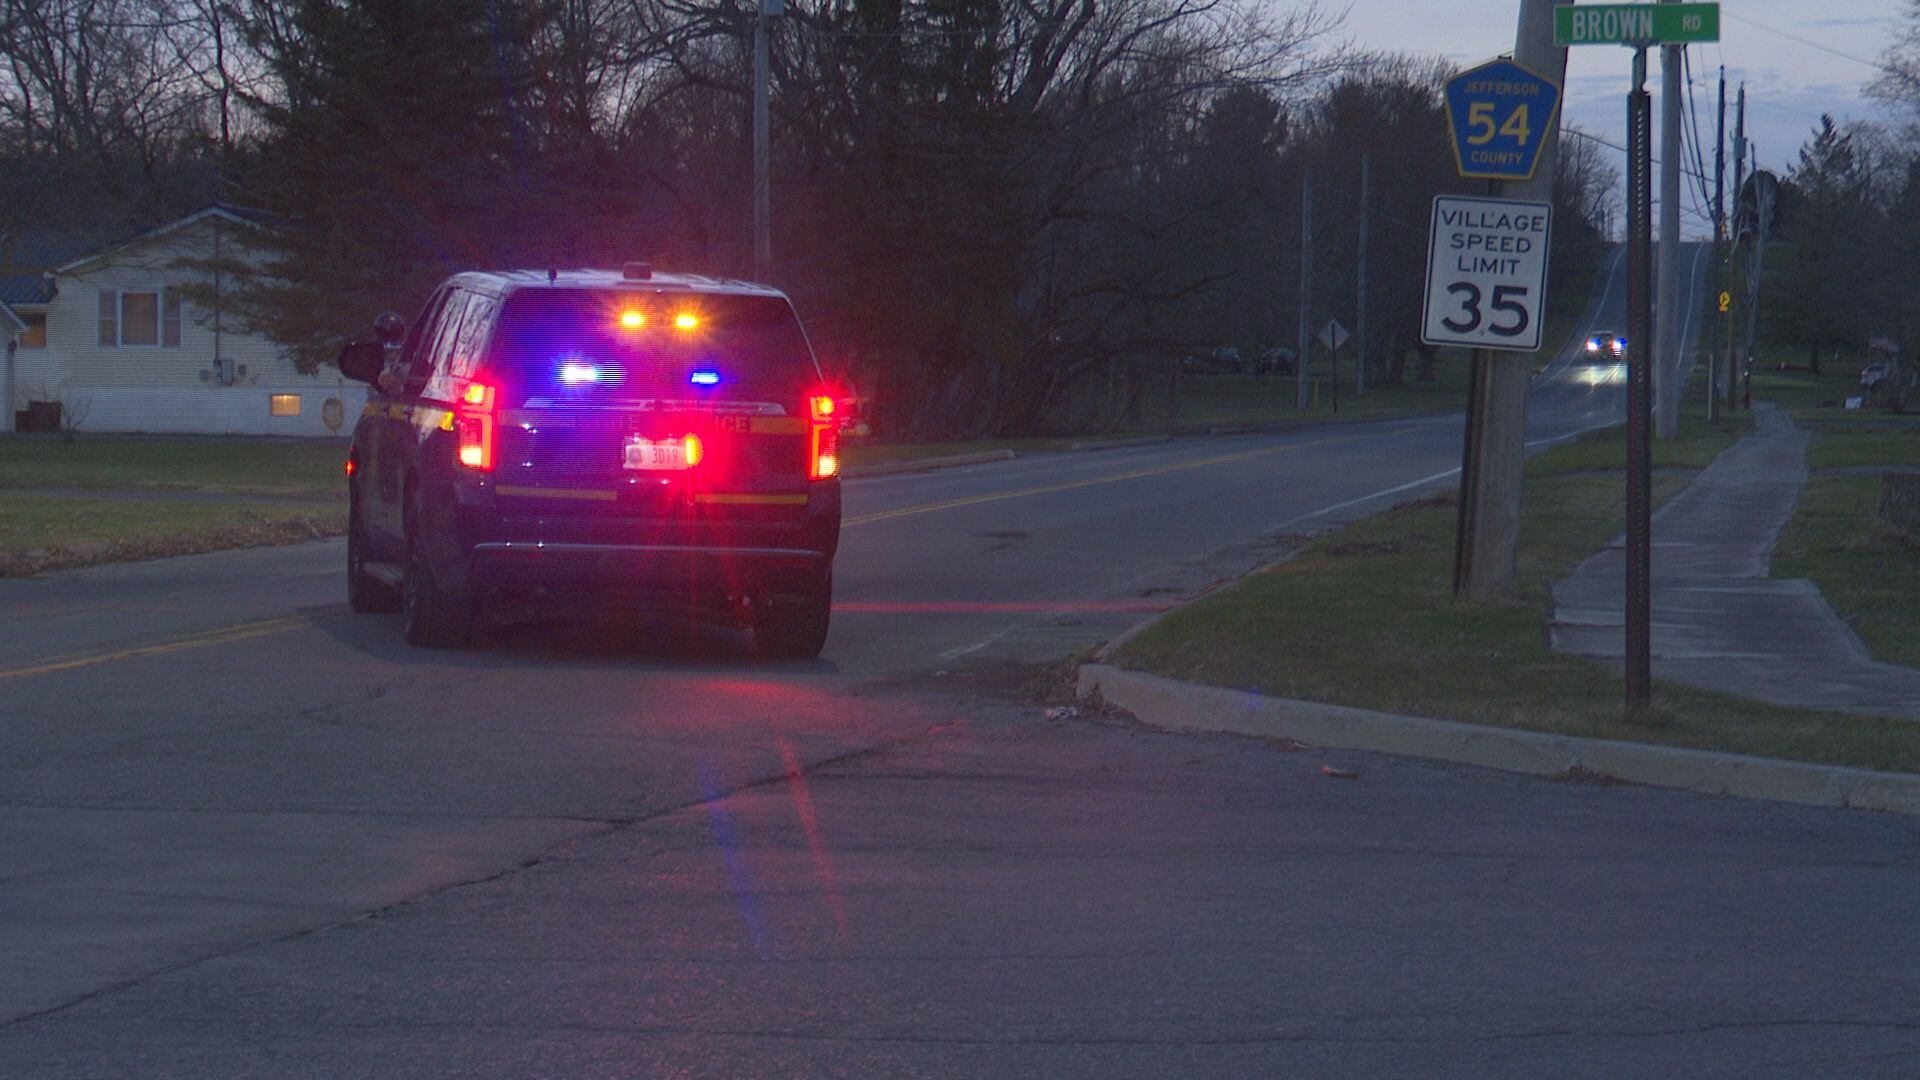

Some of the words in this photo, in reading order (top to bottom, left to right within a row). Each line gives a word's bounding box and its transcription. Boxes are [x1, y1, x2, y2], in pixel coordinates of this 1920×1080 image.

[1572, 10, 1653, 40] BROWN
[1682, 16, 1701, 31] RD
[1464, 81, 1540, 95] JEFFERSON
[1467, 103, 1530, 146] 54
[1471, 152, 1522, 165] COUNTY
[1441, 209, 1545, 233] VILLAGE
[1450, 233, 1532, 254] SPEED
[1457, 255, 1521, 276] LIMIT
[1440, 282, 1529, 337] 35
